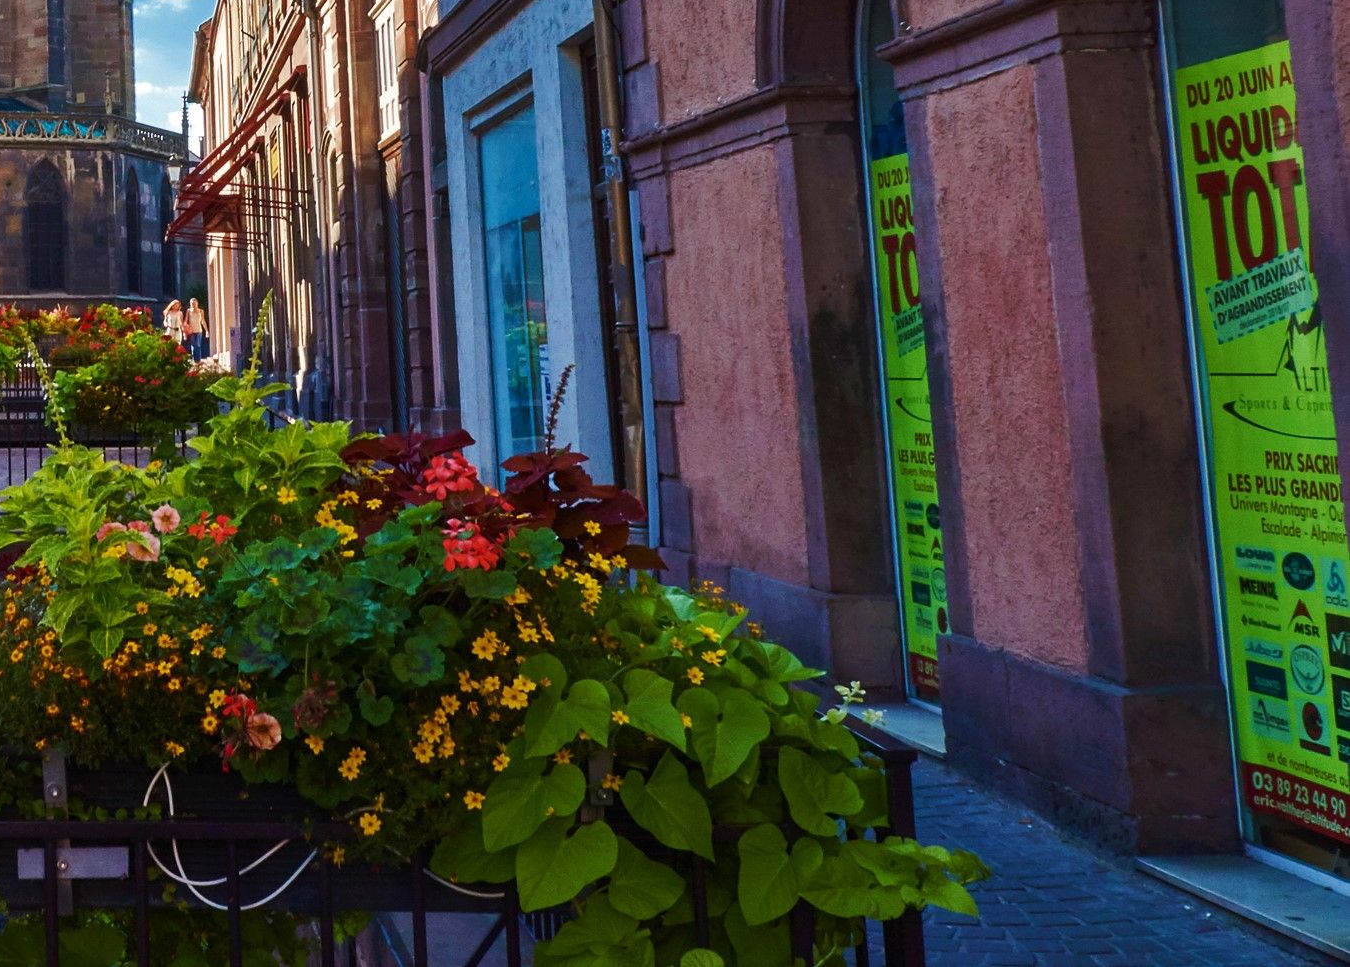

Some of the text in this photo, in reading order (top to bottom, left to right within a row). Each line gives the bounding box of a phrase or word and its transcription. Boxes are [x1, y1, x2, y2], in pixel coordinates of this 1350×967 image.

[1186, 80, 1210, 108] DU
[1214, 75, 1234, 102] 20
[1238, 65, 1274, 97] JUIN
[1191, 105, 1300, 165] LIQUID
[877, 171, 890, 189] DU
[891, 168, 903, 186] 20
[1196, 158, 1315, 281] TOT
[1214, 255, 1303, 307] AVANT TRAVAUX
[1217, 276, 1307, 325] D'AGRANDISSEMENT
[1265, 450, 1294, 471] PRIX
[1228, 473, 1252, 493] LES
[1255, 475, 1287, 497] PLUS
[1230, 494, 1269, 513] Univers
[1270, 499, 1318, 521] Montagne
[1261, 517, 1302, 538] Escalade
[1294, 622, 1321, 638] MSR
[1277, 754, 1287, 767] de
[1289, 759, 1337, 783] nombreuses
[1252, 771, 1346, 818] 03 89 23 44 90
